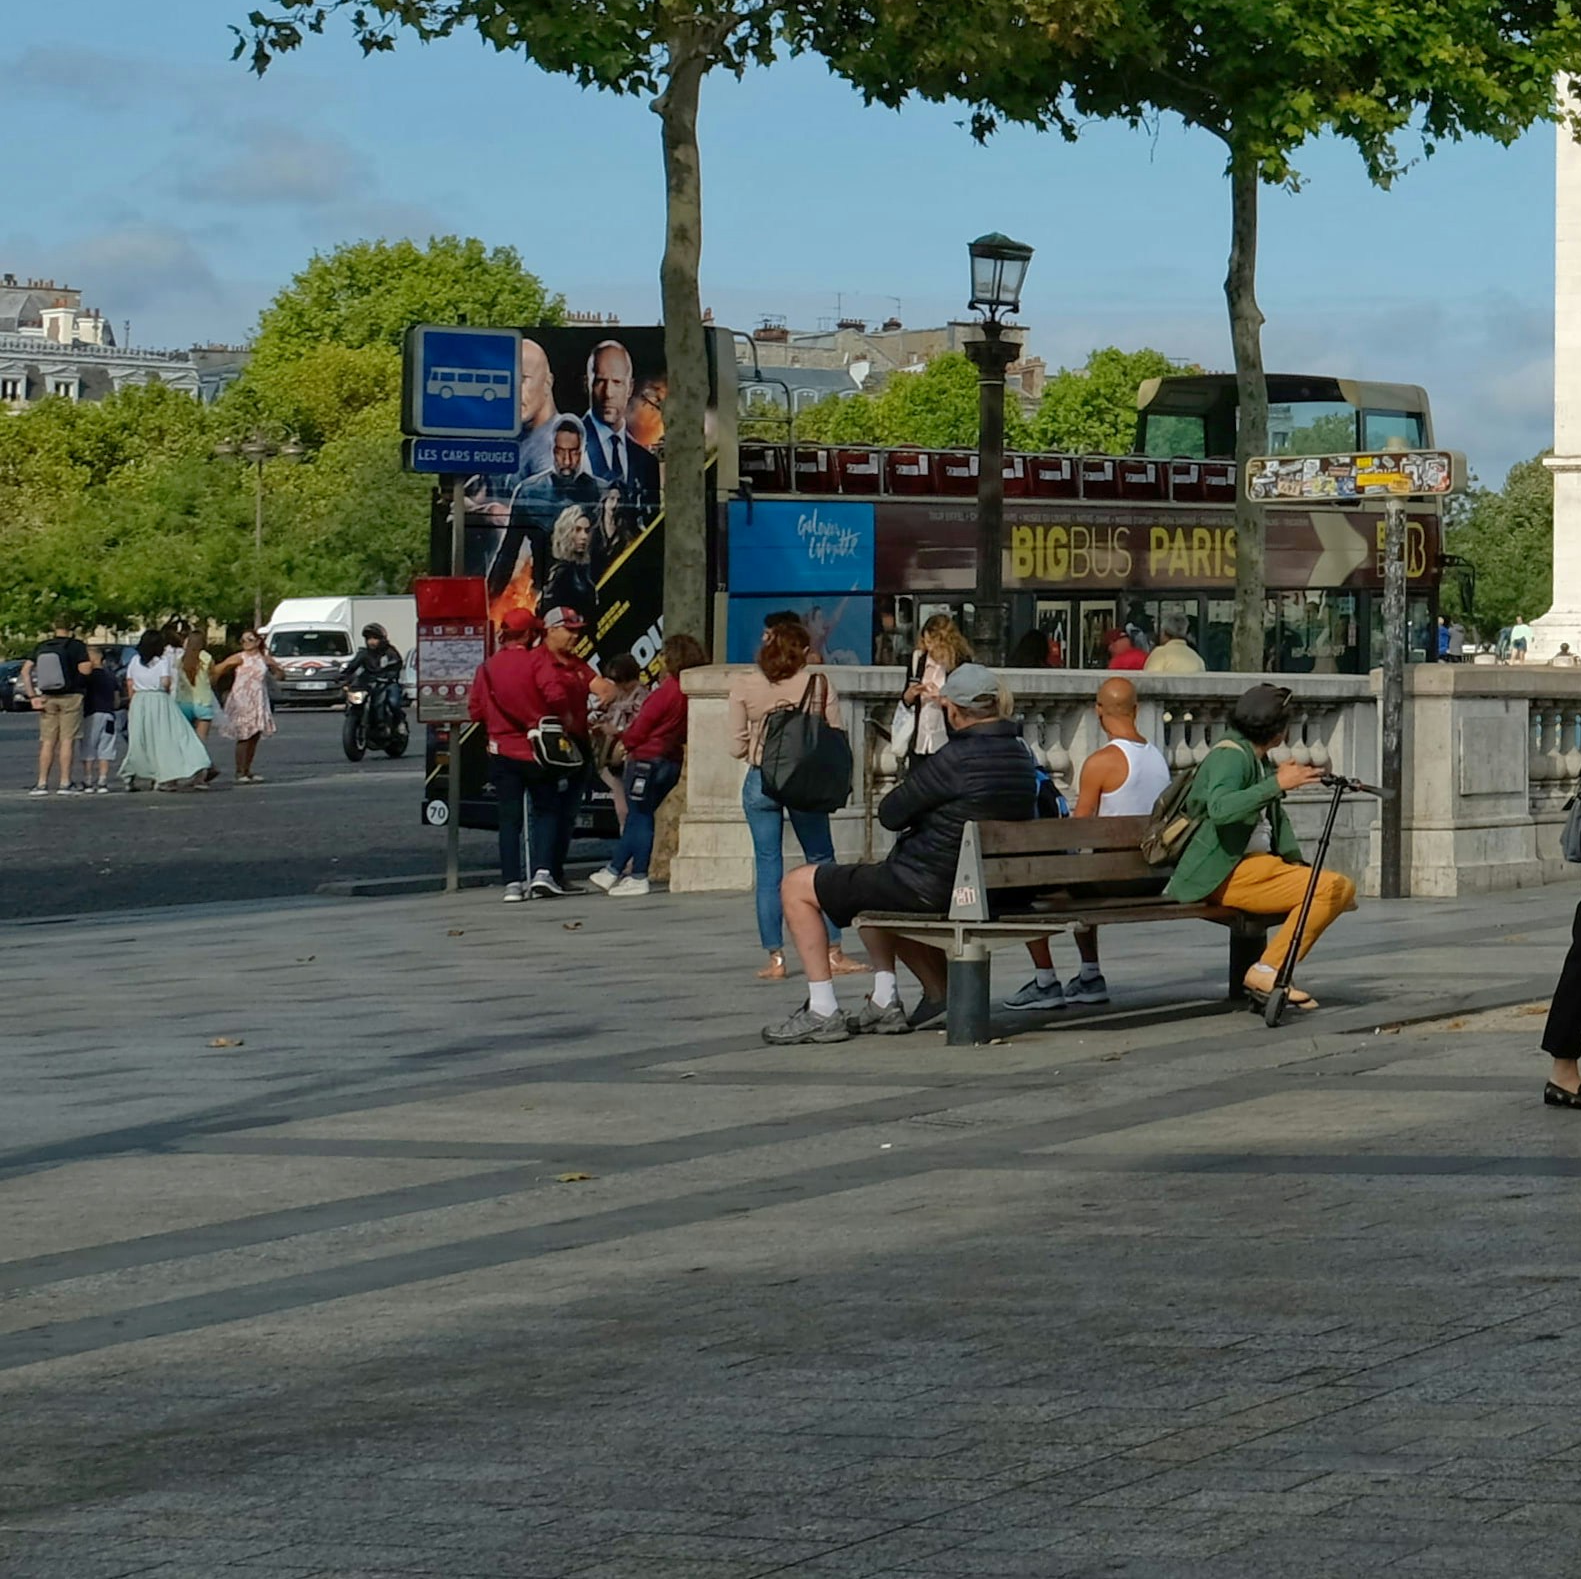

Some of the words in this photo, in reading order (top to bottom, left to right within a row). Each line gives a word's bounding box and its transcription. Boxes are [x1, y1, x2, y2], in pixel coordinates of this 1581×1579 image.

[417, 449, 438, 461] LES
[441, 449, 471, 462] CARS
[473, 451, 515, 463] ROUGES
[430, 806, 446, 820] 70
